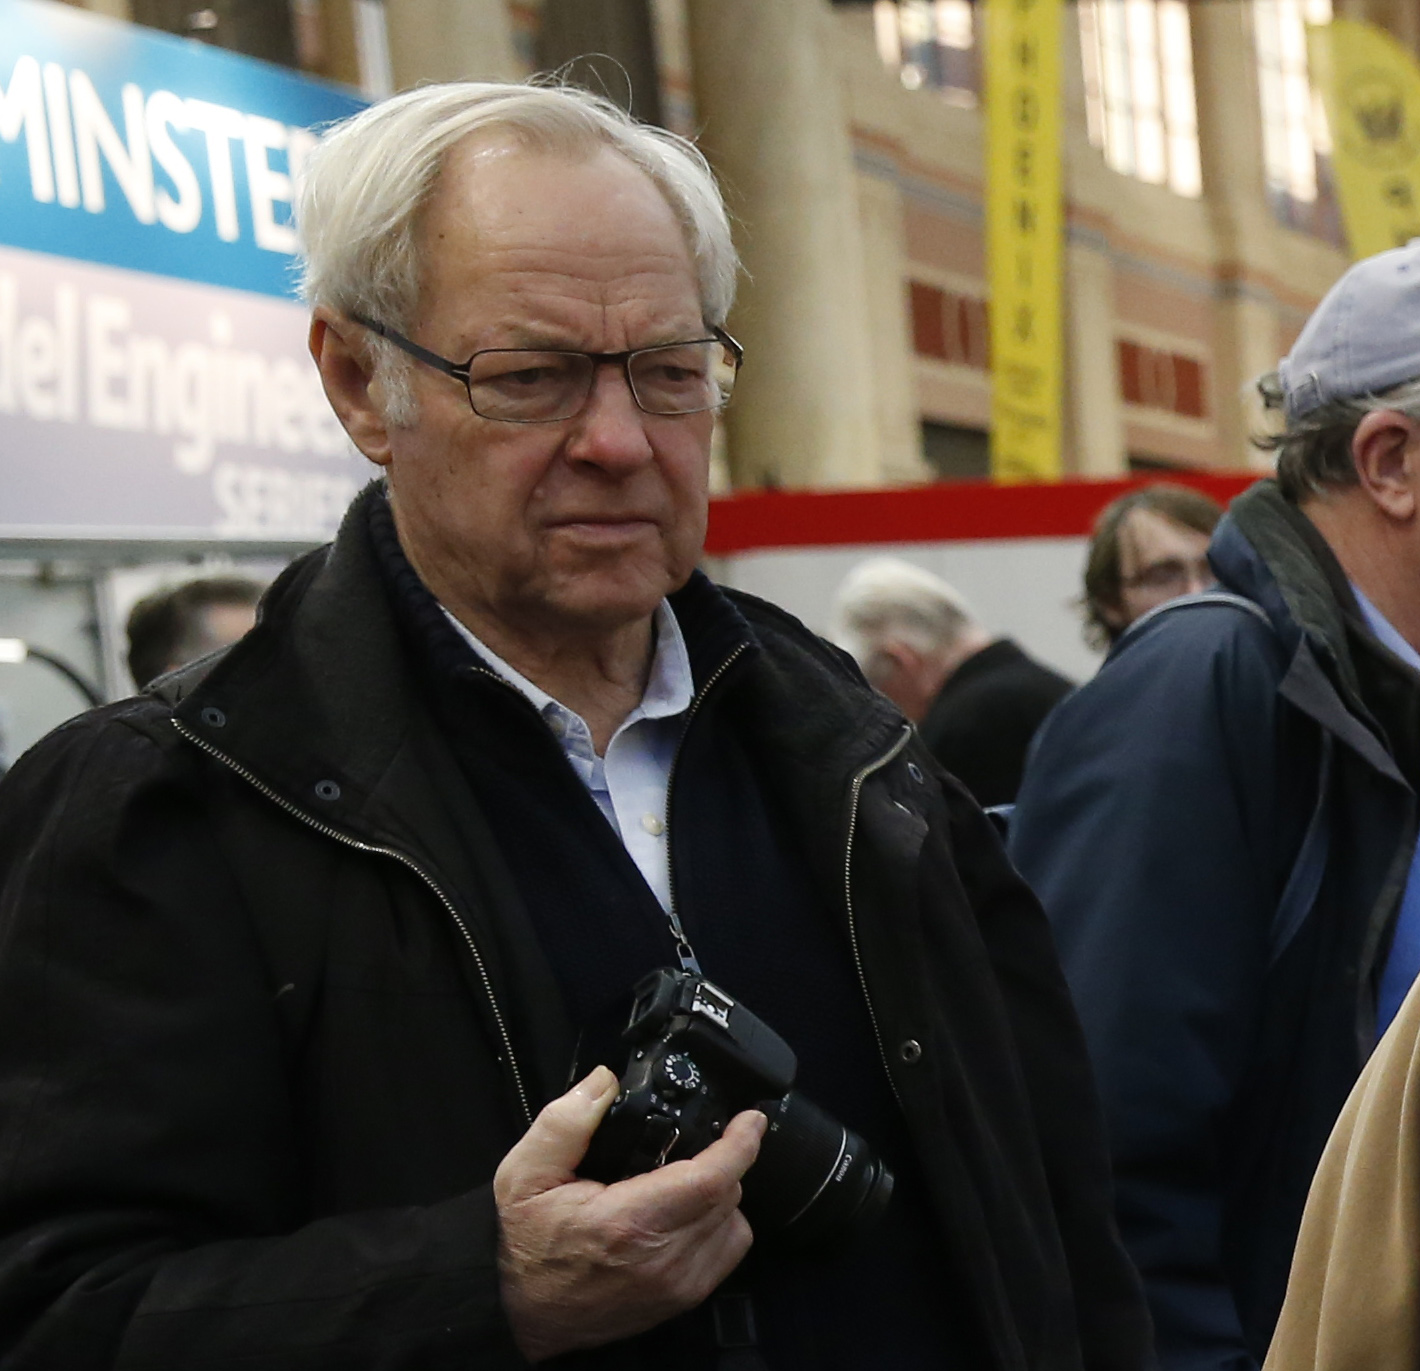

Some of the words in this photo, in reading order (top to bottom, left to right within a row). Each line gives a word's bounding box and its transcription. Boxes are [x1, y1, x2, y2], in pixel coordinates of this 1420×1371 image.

[0, 54, 314, 255] MINSTE
[87, 294, 352, 475] Enginee
[212, 462, 350, 534] SERIE
[834, 1153, 853, 1182] Canon
